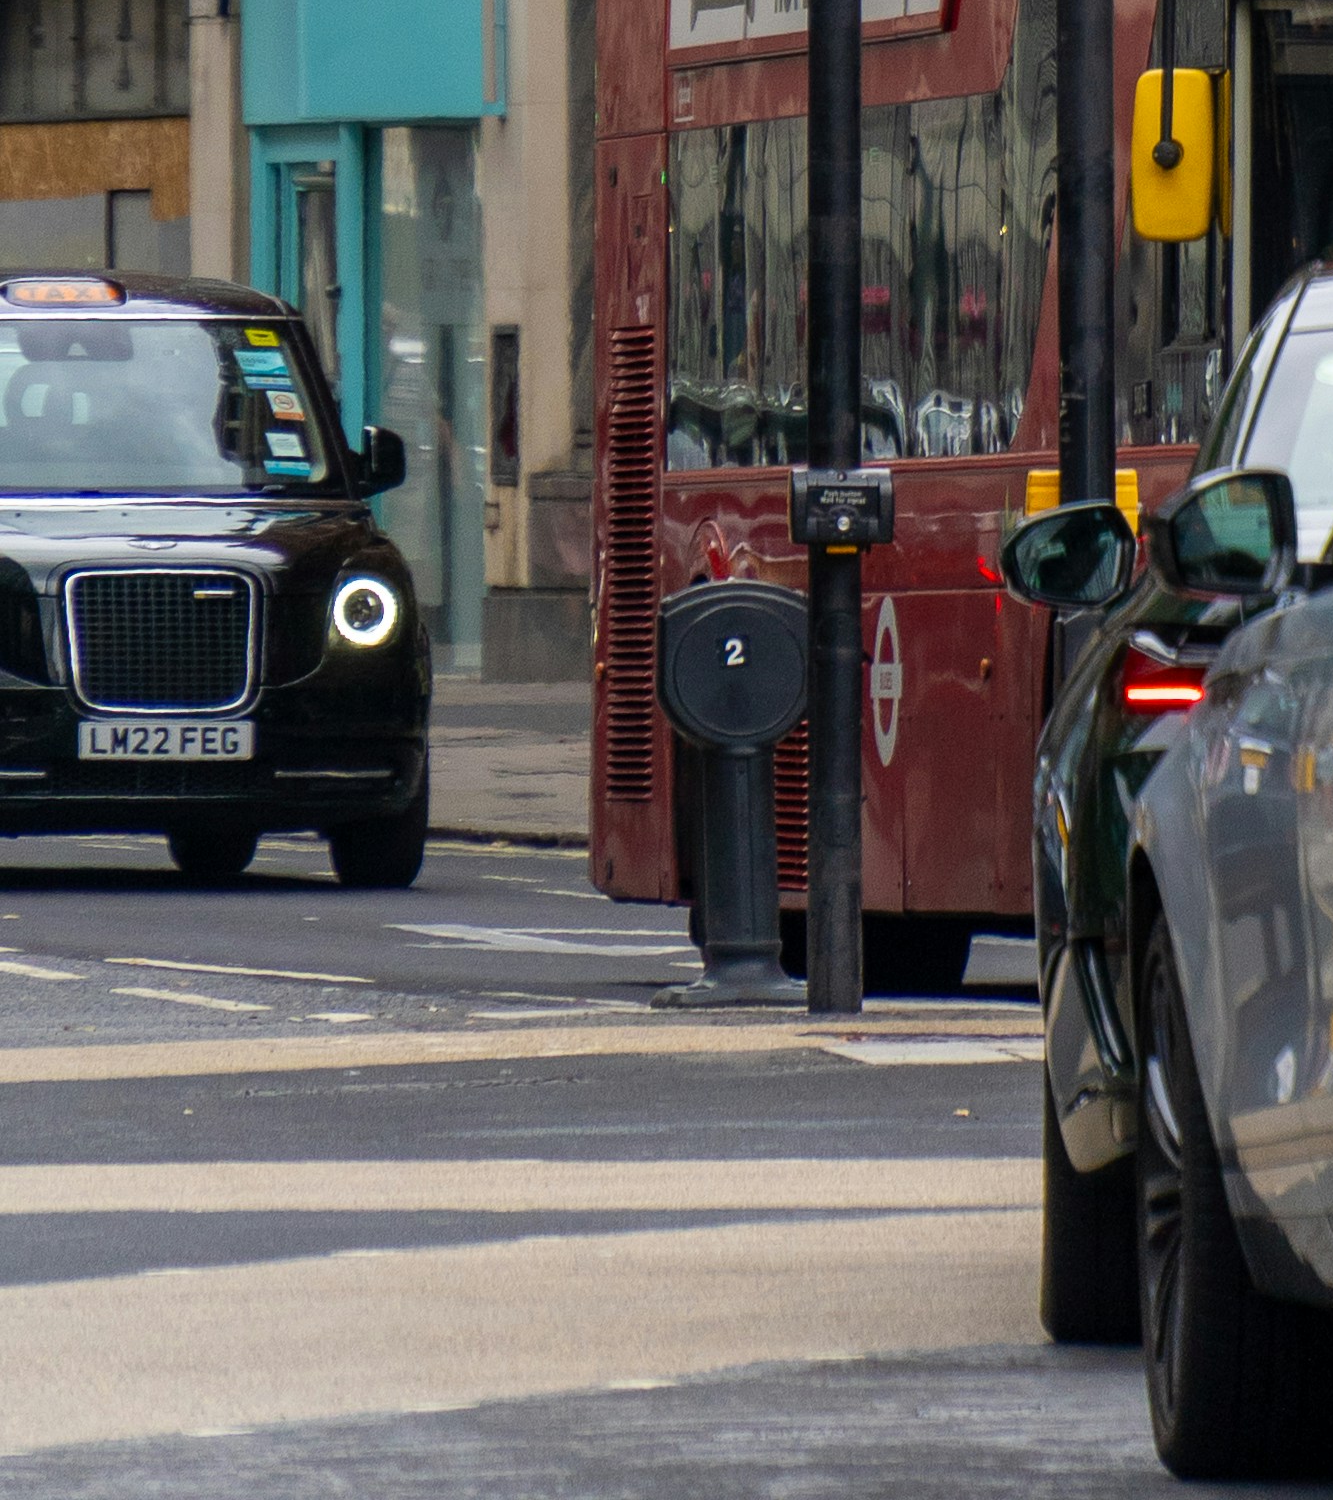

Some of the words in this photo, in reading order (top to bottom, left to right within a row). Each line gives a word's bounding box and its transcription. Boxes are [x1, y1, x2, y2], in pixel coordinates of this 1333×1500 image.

[725, 637, 745, 666] 2
[89, 727, 170, 756] LM22
[179, 726, 239, 754] FEG
